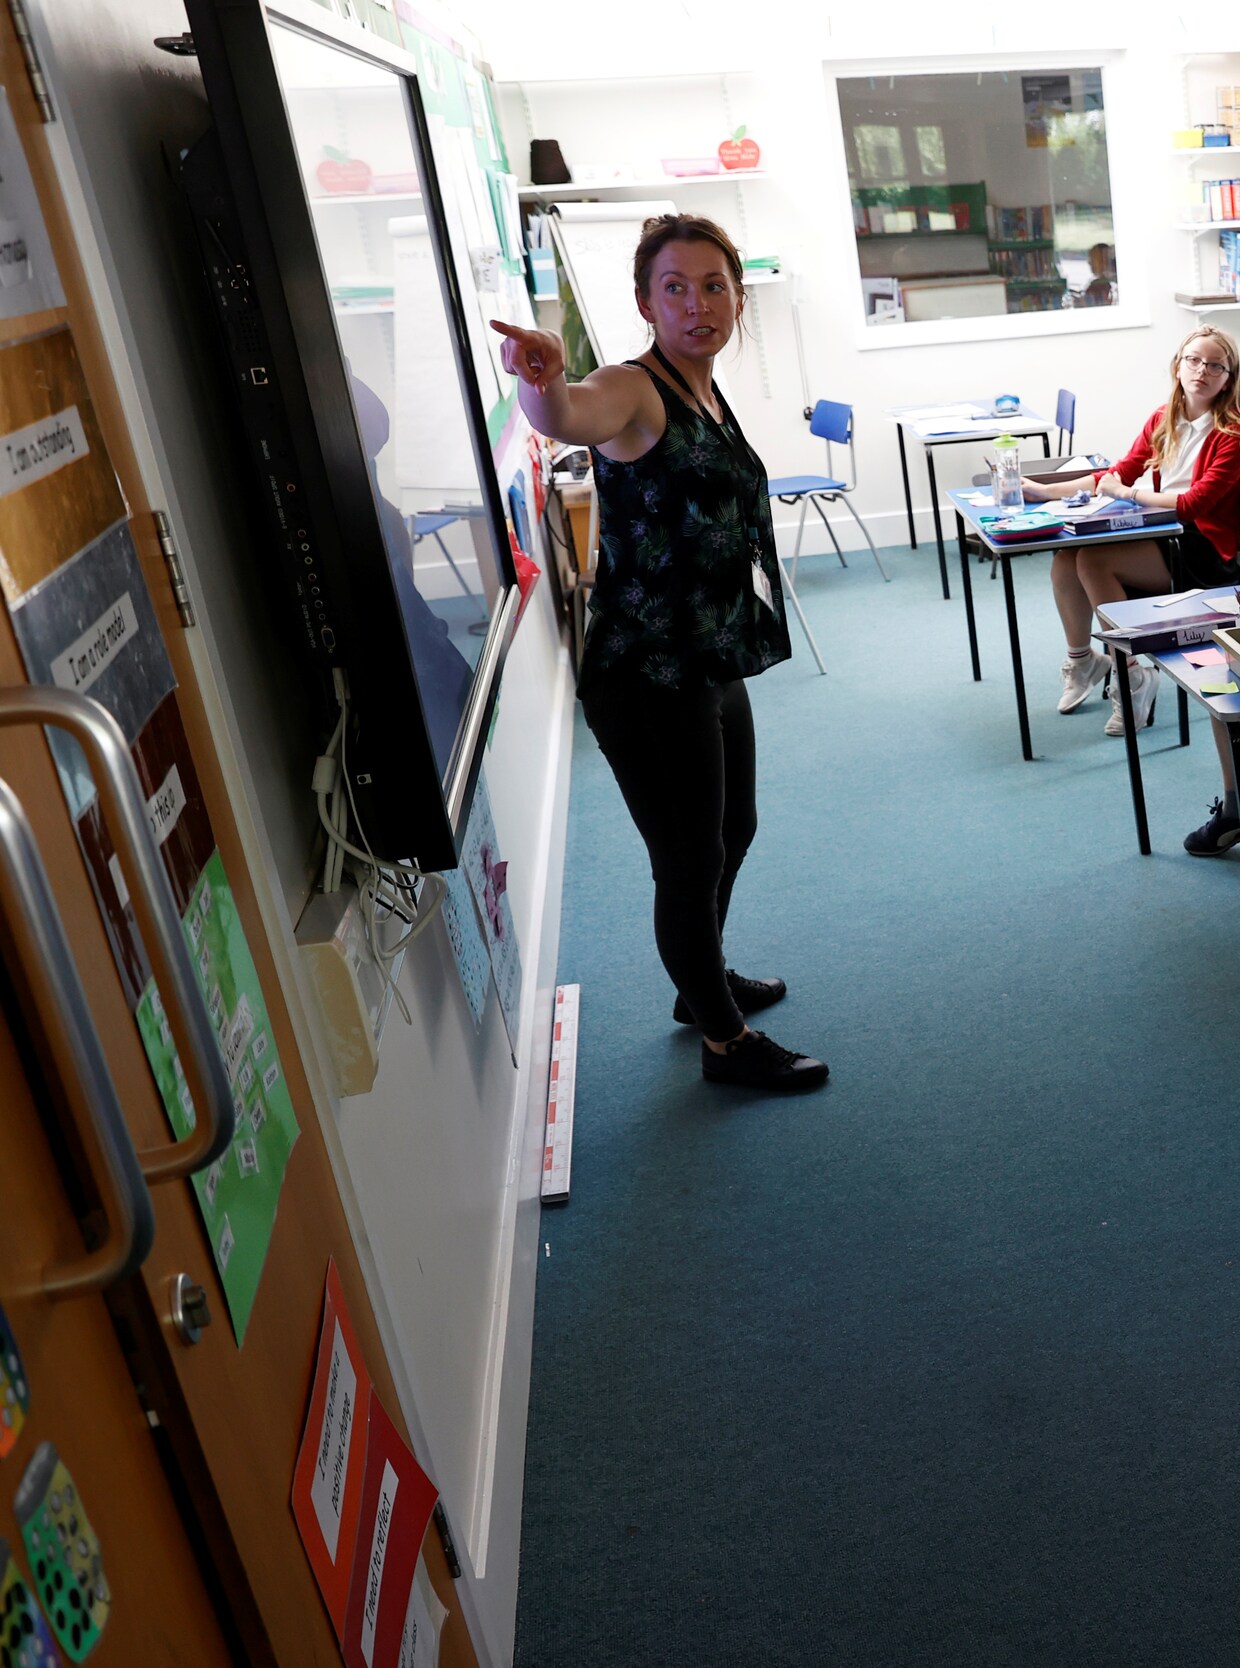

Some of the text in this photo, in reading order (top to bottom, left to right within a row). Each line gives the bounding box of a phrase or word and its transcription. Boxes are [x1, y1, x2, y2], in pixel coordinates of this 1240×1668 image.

[30, 419, 76, 470] outstanding
[68, 656, 81, 687] I
[94, 628, 110, 664] role
[106, 605, 126, 646] model
[1183, 626, 1205, 645] Lily
[154, 797, 171, 828] this
[322, 1418, 332, 1467] need
[329, 1366, 338, 1405] make
[331, 1391, 353, 1519] positive change
[367, 1564, 379, 1618] need
[376, 1490, 392, 1552] reflect
